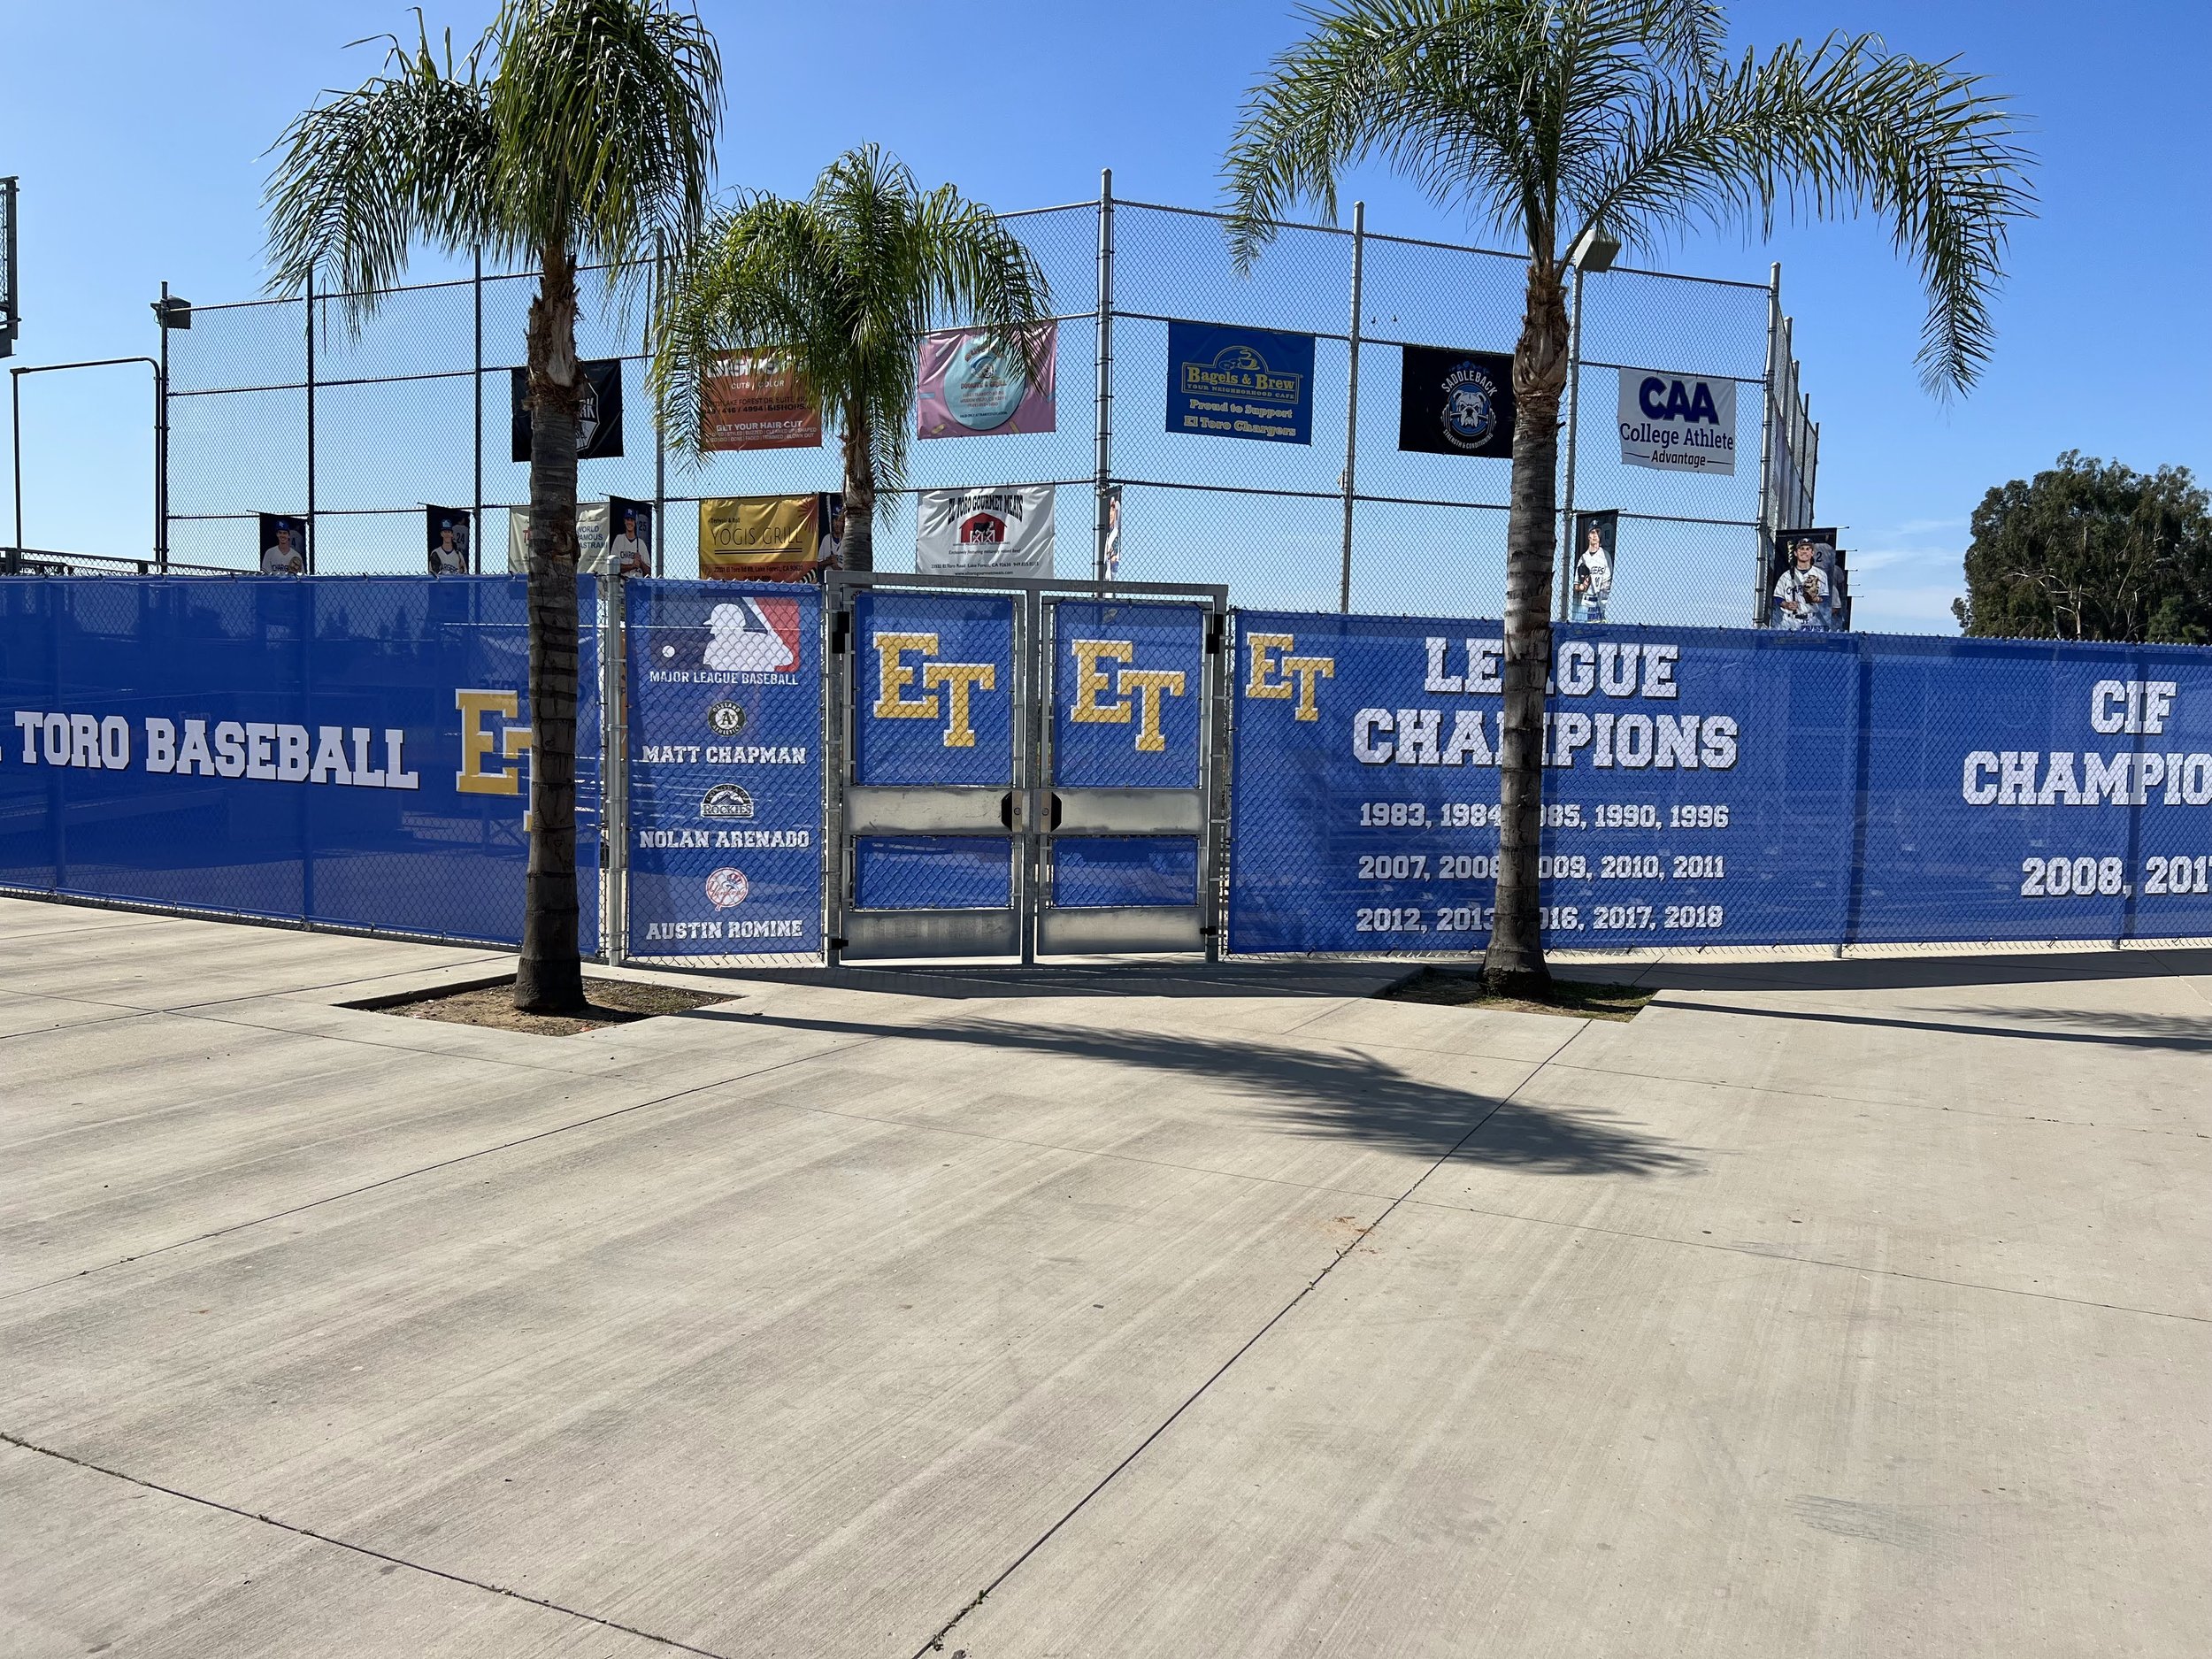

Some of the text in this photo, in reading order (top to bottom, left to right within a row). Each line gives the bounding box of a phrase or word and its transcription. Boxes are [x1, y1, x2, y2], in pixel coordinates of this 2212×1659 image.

[1187, 366, 1295, 390] Bagels & Brew
[1440, 370, 1498, 396] SADDLEBACK
[1211, 386, 1272, 397] NEIGHBORHOOD
[1639, 376, 1720, 426] CAA
[1189, 398, 1293, 419] Proud to Support
[734, 422, 758, 431] YOUR
[1184, 415, 1296, 437] El Toro Chargers
[1620, 423, 1733, 450] College Athlete
[1651, 449, 1706, 468] Advantage
[956, 495, 972, 518] TORO
[972, 495, 1003, 511] GOURMET
[1003, 495, 1024, 523] MEATS
[710, 526, 803, 546] YOGIS GRILL
[1816, 551, 1823, 563] 2
[649, 671, 798, 686] MAJOR LEAGUE BASEBALL
[1246, 632, 1334, 722] ET
[1425, 637, 1678, 696] LEGUE
[872, 631, 995, 748] ET
[1070, 639, 1185, 751] ET
[2091, 680, 2177, 734] CIF
[15, 710, 418, 789] TORO BASEBALL
[642, 745, 807, 764] MATT CHAPMAN
[1962, 750, 2212, 805] CHAMPIO
[703, 804, 752, 814] ROCKIES
[1360, 803, 1432, 828] 1983,
[1595, 804, 1663, 830] 1990,
[1670, 804, 1730, 828] 1996
[639, 830, 810, 849] NOLAN ARENADO
[1358, 855, 1431, 881] 2007,
[1539, 855, 1593, 882] 009,
[1601, 855, 1665, 881] 2010,
[1673, 856, 1724, 879] 2011
[2021, 856, 2212, 899] 2008, 201
[646, 919, 803, 941] AUSTIN ROMINE
[1356, 908, 1428, 933] 2012,
[1540, 906, 1586, 932] 016,
[1594, 905, 1657, 932] 2017,
[1664, 905, 1724, 929] 2018
